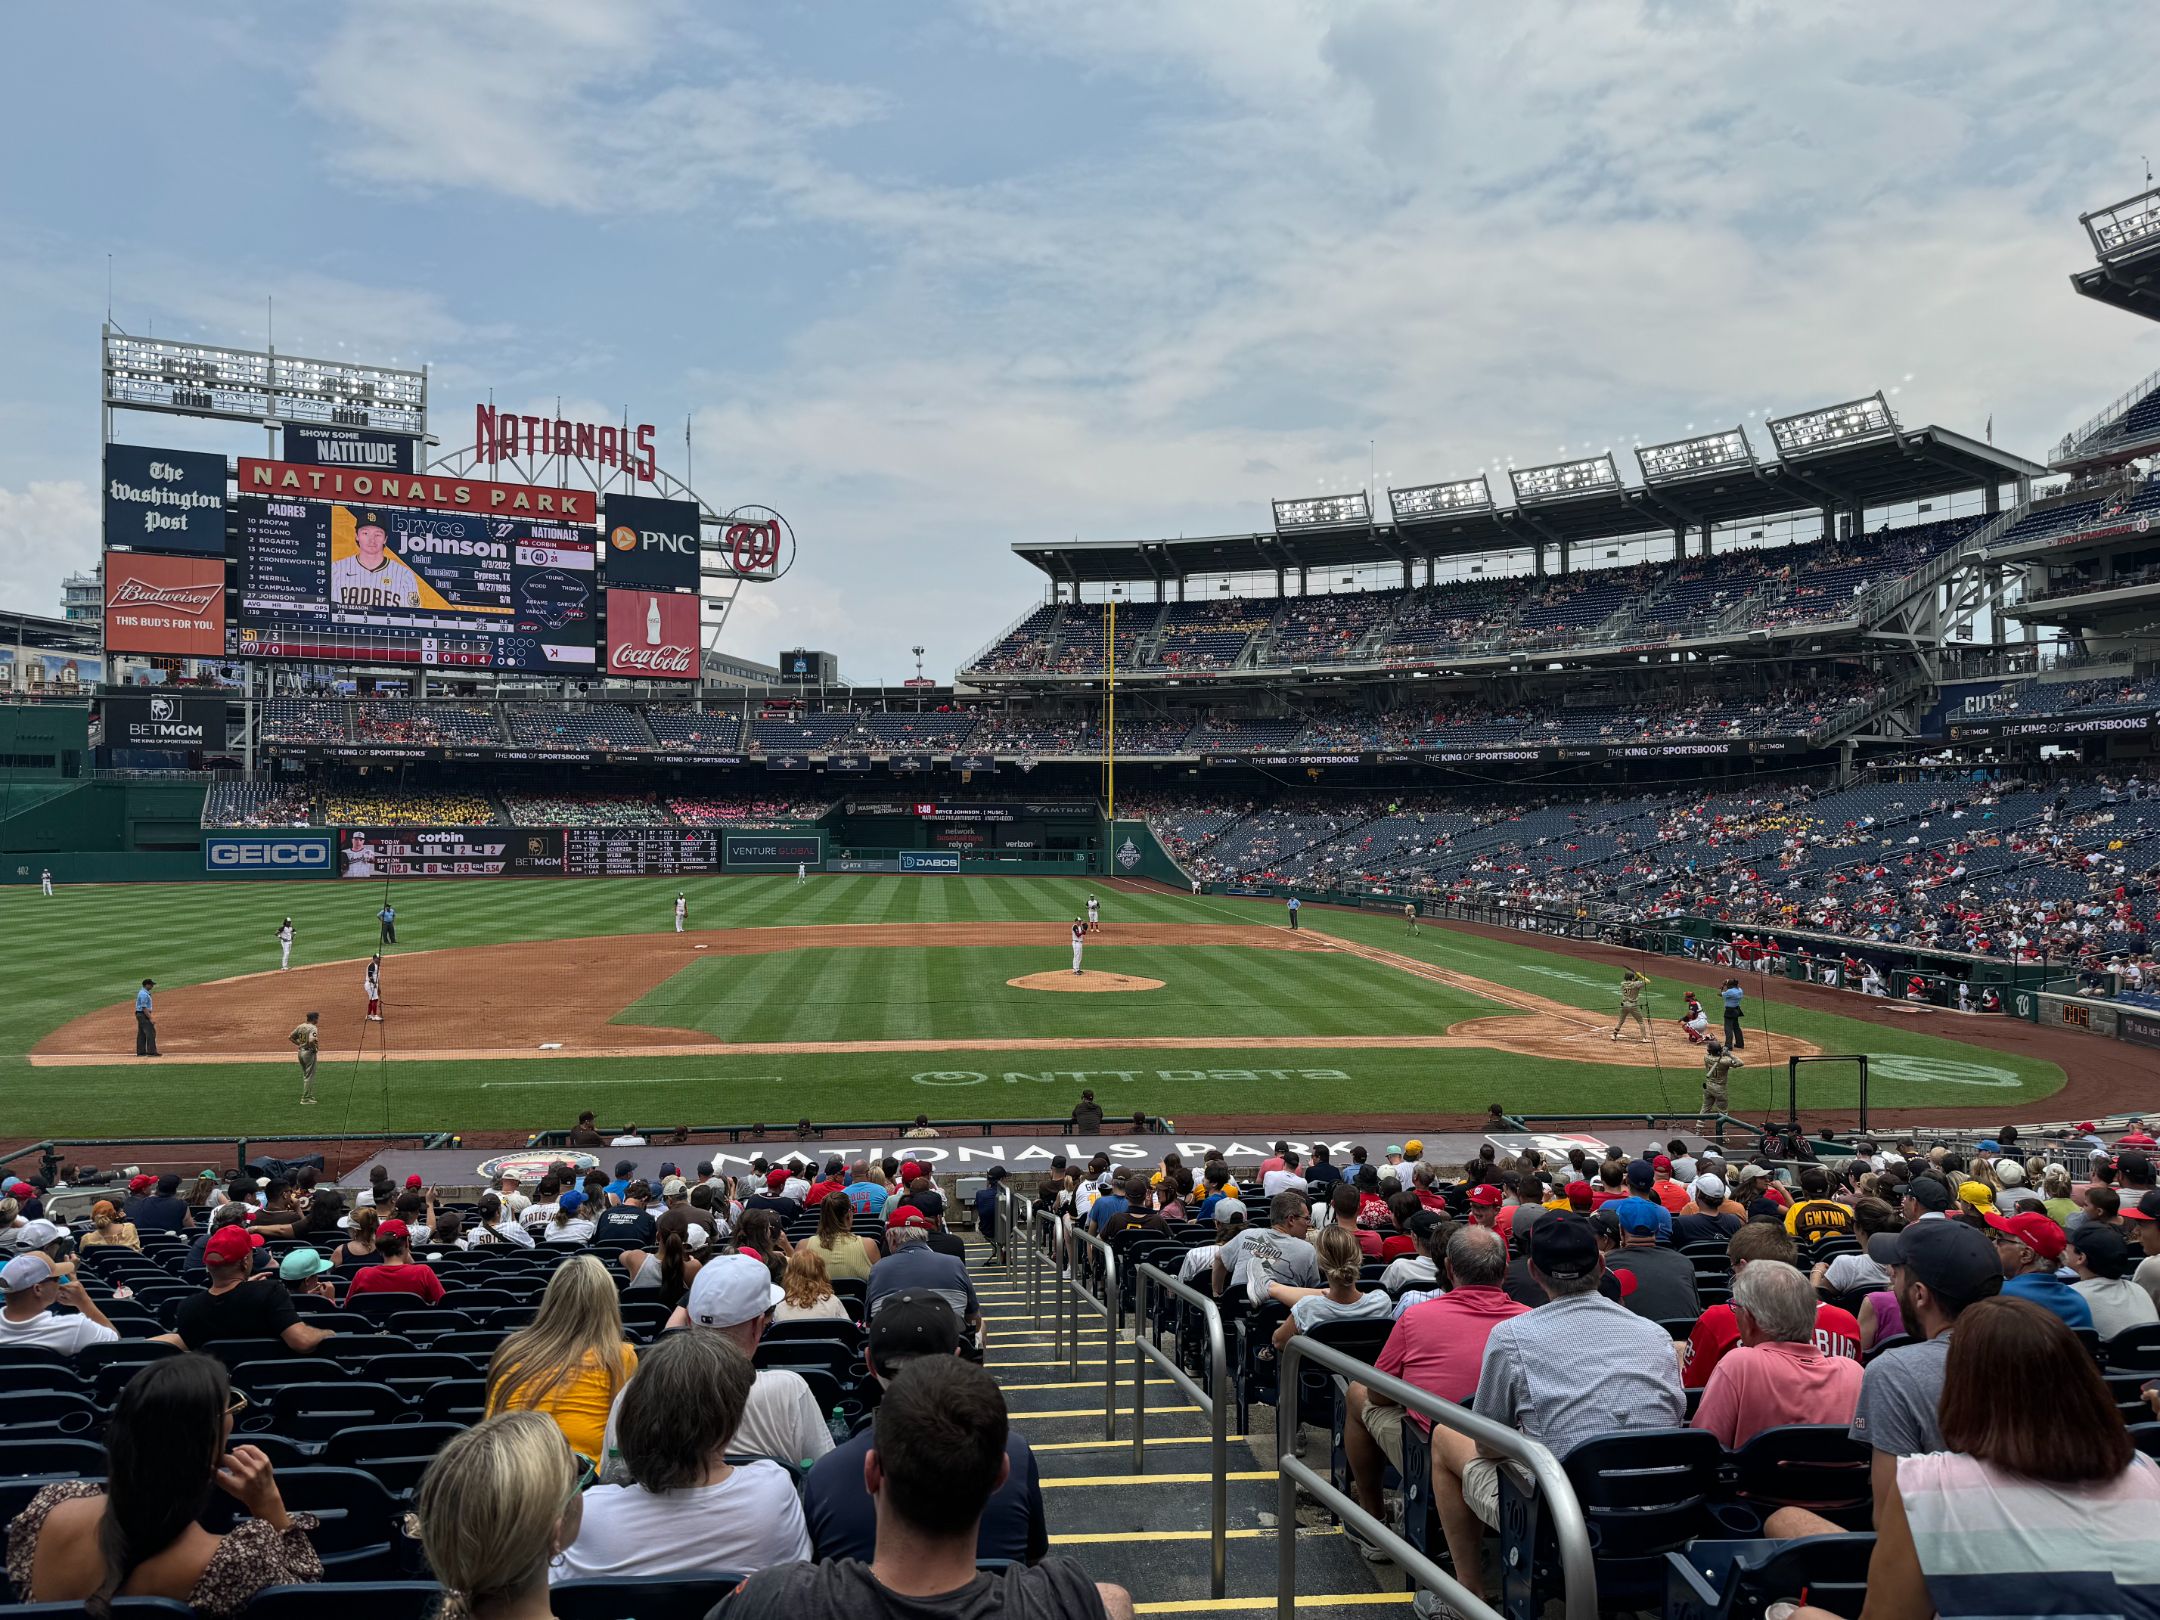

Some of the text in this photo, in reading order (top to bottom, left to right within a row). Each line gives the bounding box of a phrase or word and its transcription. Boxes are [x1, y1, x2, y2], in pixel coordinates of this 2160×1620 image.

[299, 429, 360, 440] SHOW SOME
[476, 403, 656, 482] NATIONALS
[317, 440, 397, 464] NATITUDE
[149, 461, 184, 483] The
[110, 479, 222, 510] Washington
[253, 466, 578, 514] NATIONALS PARK
[267, 503, 306, 518] PADRES
[144, 511, 188, 533] Post
[259, 518, 290, 527] PROFAR
[391, 514, 465, 538] bryce
[259, 528, 291, 536] SOLANO
[531, 526, 579, 541] NATIONALS
[259, 537, 300, 546] BOGAERTS
[398, 531, 507, 558] johnson
[640, 530, 696, 555] PNC
[259, 547, 298, 555] MACHADO
[258, 556, 316, 566] CRONENWORTH
[481, 560, 511, 569] 8/3/2022
[259, 574, 291, 582] MERRILL
[474, 571, 502, 582] Cypress,
[502, 573, 511, 582] TX
[258, 584, 307, 593] CAMPUSANO
[477, 582, 511, 592] 10/27/1995
[117, 584, 212, 605] Budweiser
[258, 593, 296, 601] JOHNSON
[341, 586, 401, 608] PADRES
[115, 615, 216, 631] THIS BUD'S FOR YOU.
[272, 632, 279, 640] 3
[427, 640, 433, 648] 3
[460, 642, 468, 650] 0
[479, 643, 486, 651] 3
[498, 637, 505, 645] B
[271, 646, 279, 654] 0
[426, 653, 433, 661] 0
[443, 654, 450, 662] 0
[460, 655, 468, 663] 0
[479, 656, 486, 664] 4
[498, 647, 504, 655] S
[611, 642, 696, 673] Coca-Cola
[129, 723, 203, 737] BETMGM
[2001, 717, 2148, 736] THE SPORTSBOOKS
[1424, 751, 1539, 762] THE KING OF SPORTSBOOKS
[1607, 745, 1728, 757] THE KING OF SPORTSBOOKS
[1251, 755, 1359, 765] THE KING OF SPORTSBOOKS
[417, 831, 464, 843] corbin
[948, 841, 962, 849] rely
[1005, 840, 1034, 848] verizon
[211, 844, 326, 864] GEICO
[732, 847, 815, 855] VENTURE GLOBAL
[515, 857, 562, 866] BETMGM
[916, 859, 958, 867] DABOS
[16, 866, 29, 875] 402
[456, 863, 500, 873] 2-9 5.54
[2016, 994, 2030, 1017] W
[2063, 1004, 2089, 1026] 0:09
[2134, 1024, 2148, 1035] MLB
[1002, 1070, 1144, 1084] NTT
[1764, 1139, 1781, 1153] 27
[711, 1140, 1354, 1177] NATIONALS PARK
[524, 1212, 547, 1224] TATIS
[1805, 1210, 1846, 1226] GWYNN
[479, 1233, 502, 1244] SOT
[1242, 1241, 1283, 1259] MID-OHIO
